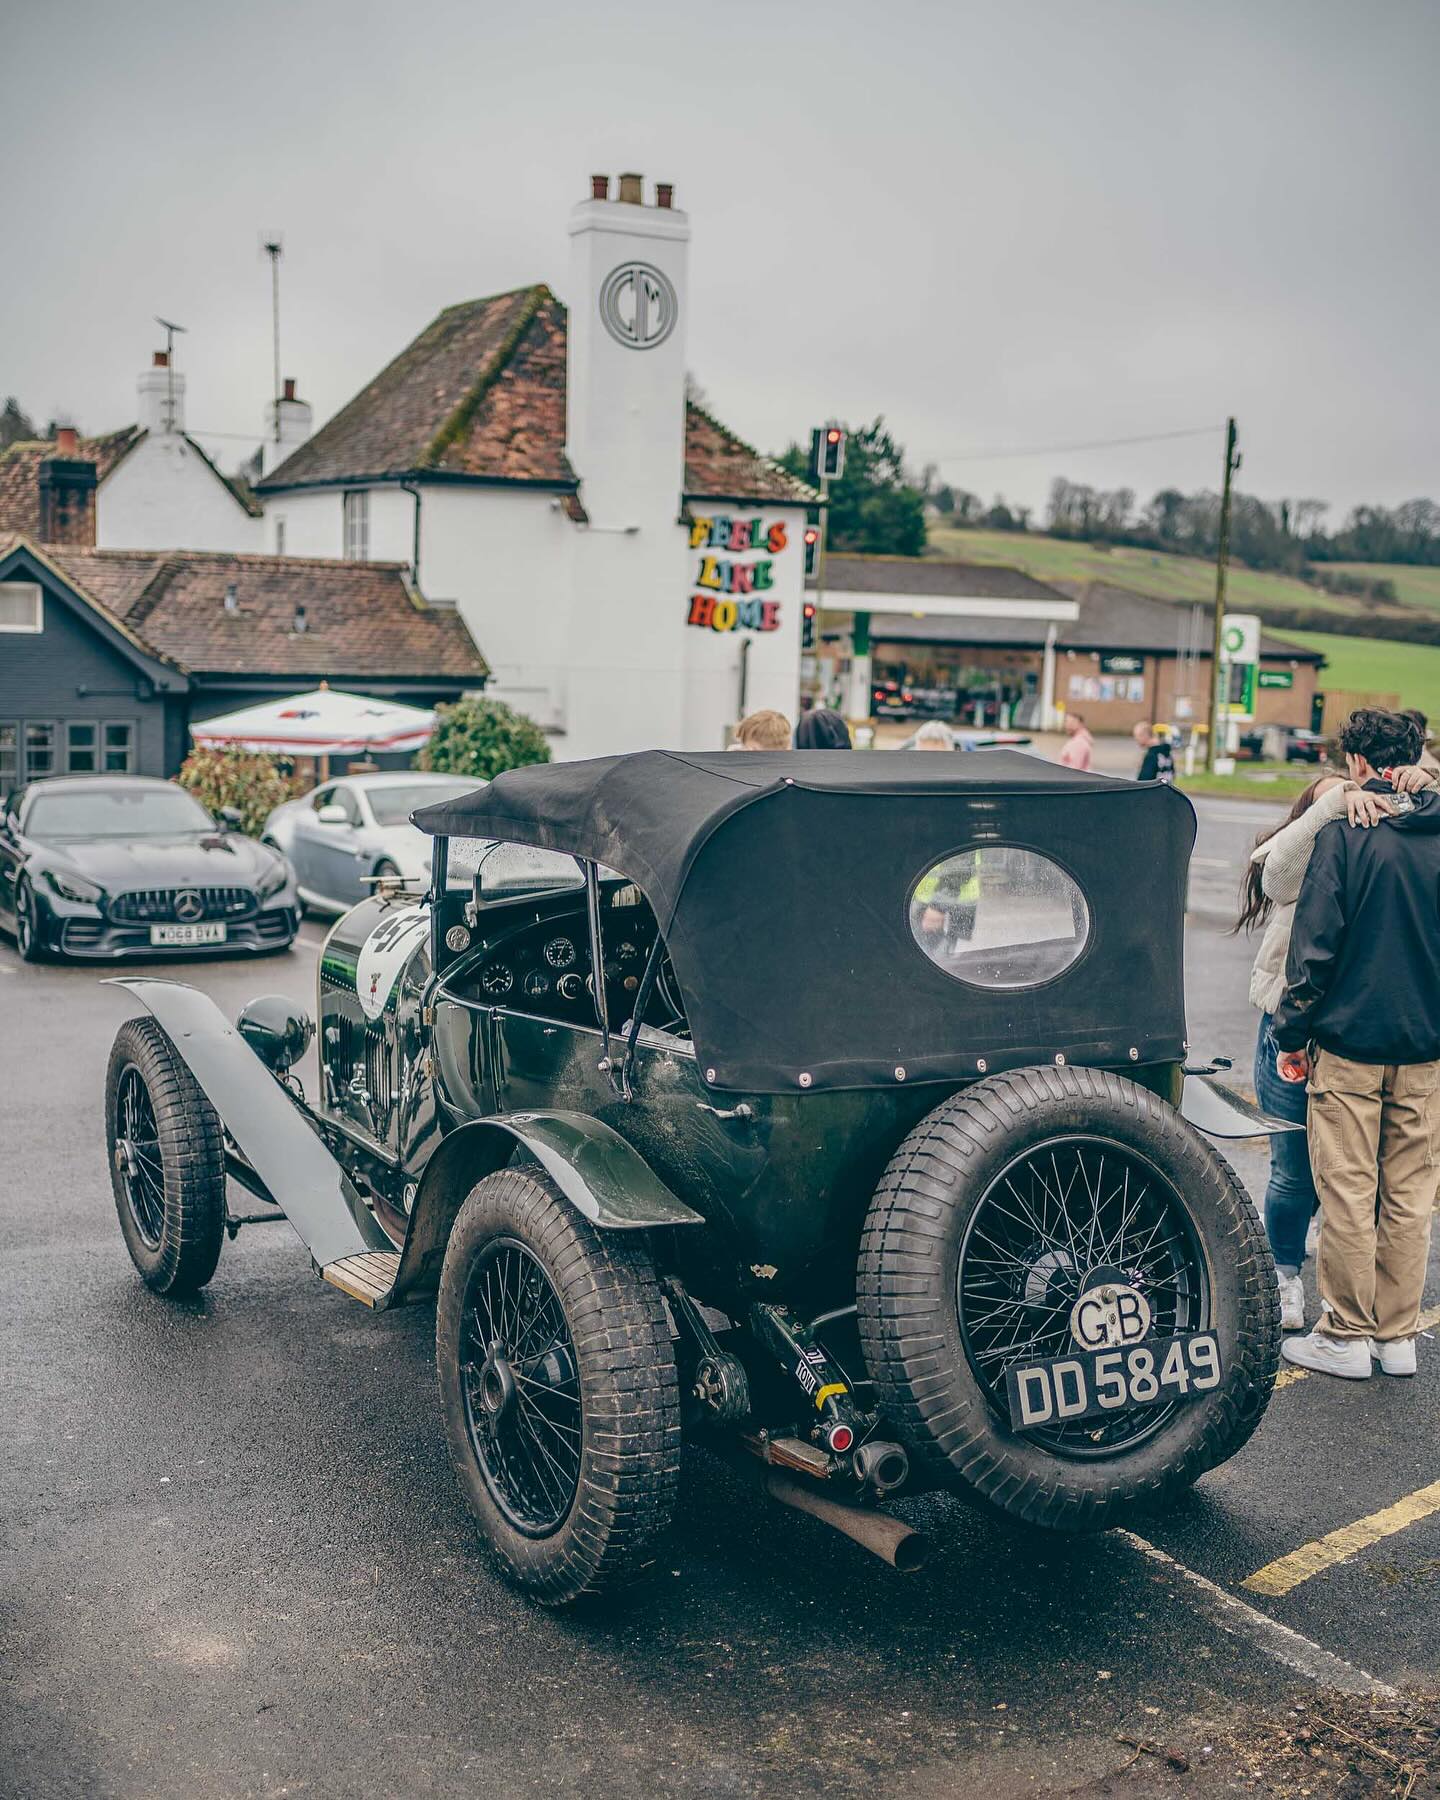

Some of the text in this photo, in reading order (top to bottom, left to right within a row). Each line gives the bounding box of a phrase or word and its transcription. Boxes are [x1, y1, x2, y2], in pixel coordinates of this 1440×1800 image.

[689, 517, 787, 552] FEELS
[697, 556, 773, 593] LIKE
[688, 595, 780, 631] HOME
[1078, 1293, 1144, 1345] GB
[796, 1360, 815, 1393] TOW
[1016, 1335, 1221, 1425] DD 5849
